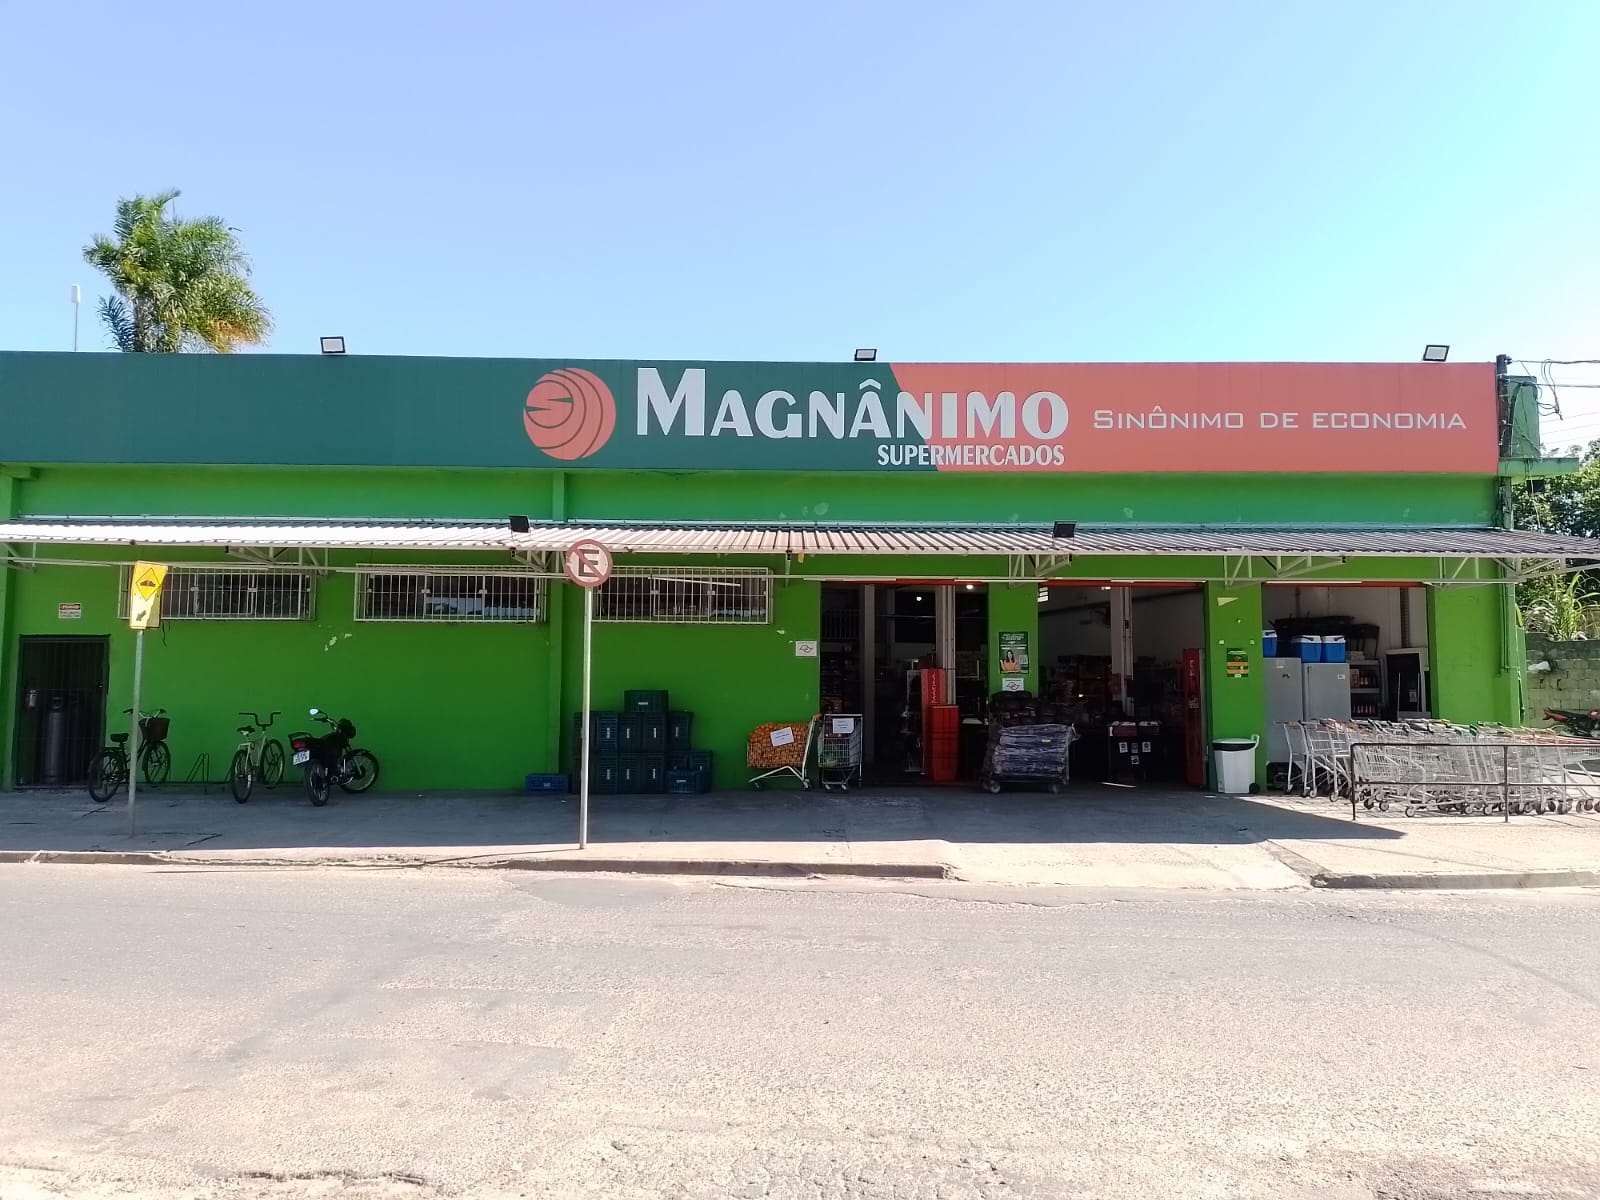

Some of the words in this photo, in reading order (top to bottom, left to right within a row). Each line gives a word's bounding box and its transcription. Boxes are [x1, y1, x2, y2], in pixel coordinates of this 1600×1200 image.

[636, 367, 1069, 440] MAGNÂNIMO
[1093, 405, 1244, 429] SINÔNIMO
[1259, 412, 1299, 429] DE
[1312, 412, 1467, 429] ECONOMIA
[877, 444, 1065, 467] SUPERMERCADOS
[578, 549, 599, 577] E
